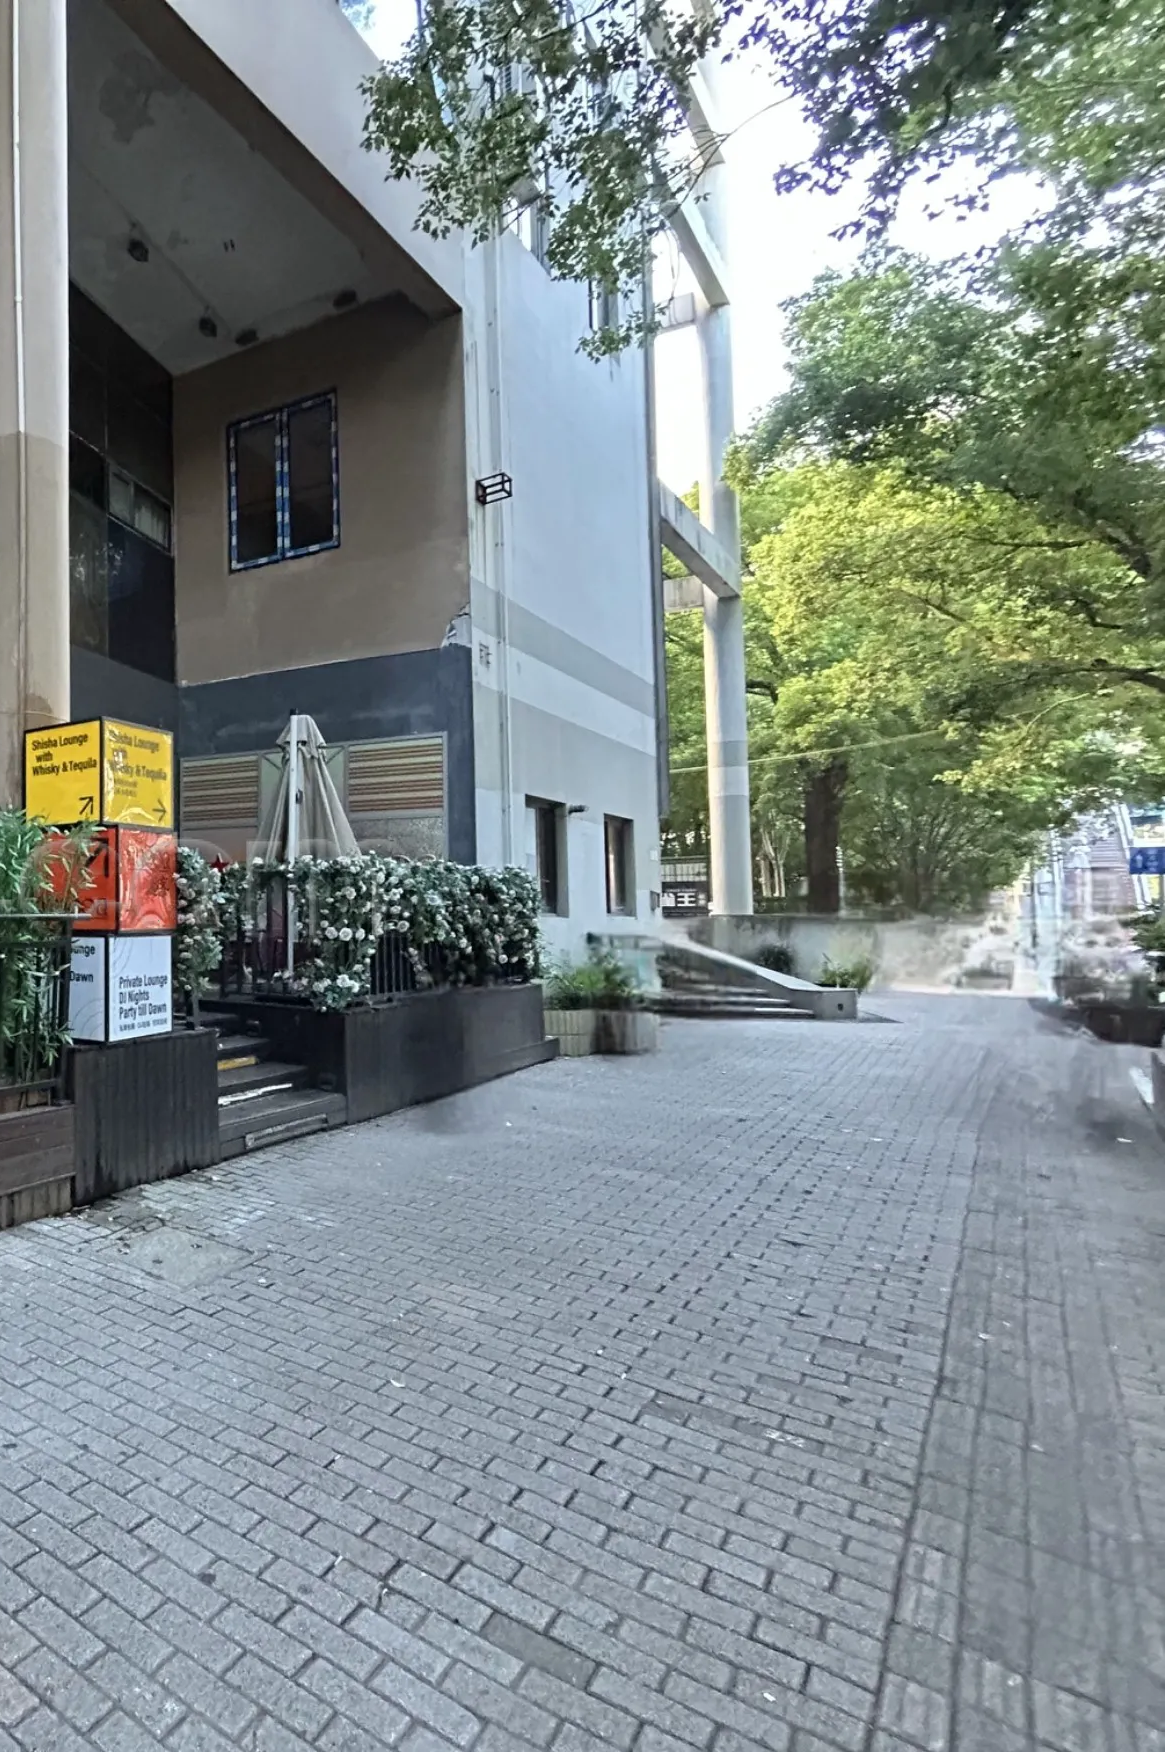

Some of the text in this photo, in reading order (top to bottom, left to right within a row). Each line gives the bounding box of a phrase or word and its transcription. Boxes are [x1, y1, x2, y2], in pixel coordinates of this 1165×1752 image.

[32, 733, 89, 752] Shisha Lounge
[35, 751, 53, 763] with
[32, 758, 97, 777] Whisky & Tequila
[70, 971, 94, 983] Dawn
[119, 974, 168, 989] Private Lounge
[128, 990, 150, 1005] Nights
[119, 1003, 167, 1021] Party till Dawn
